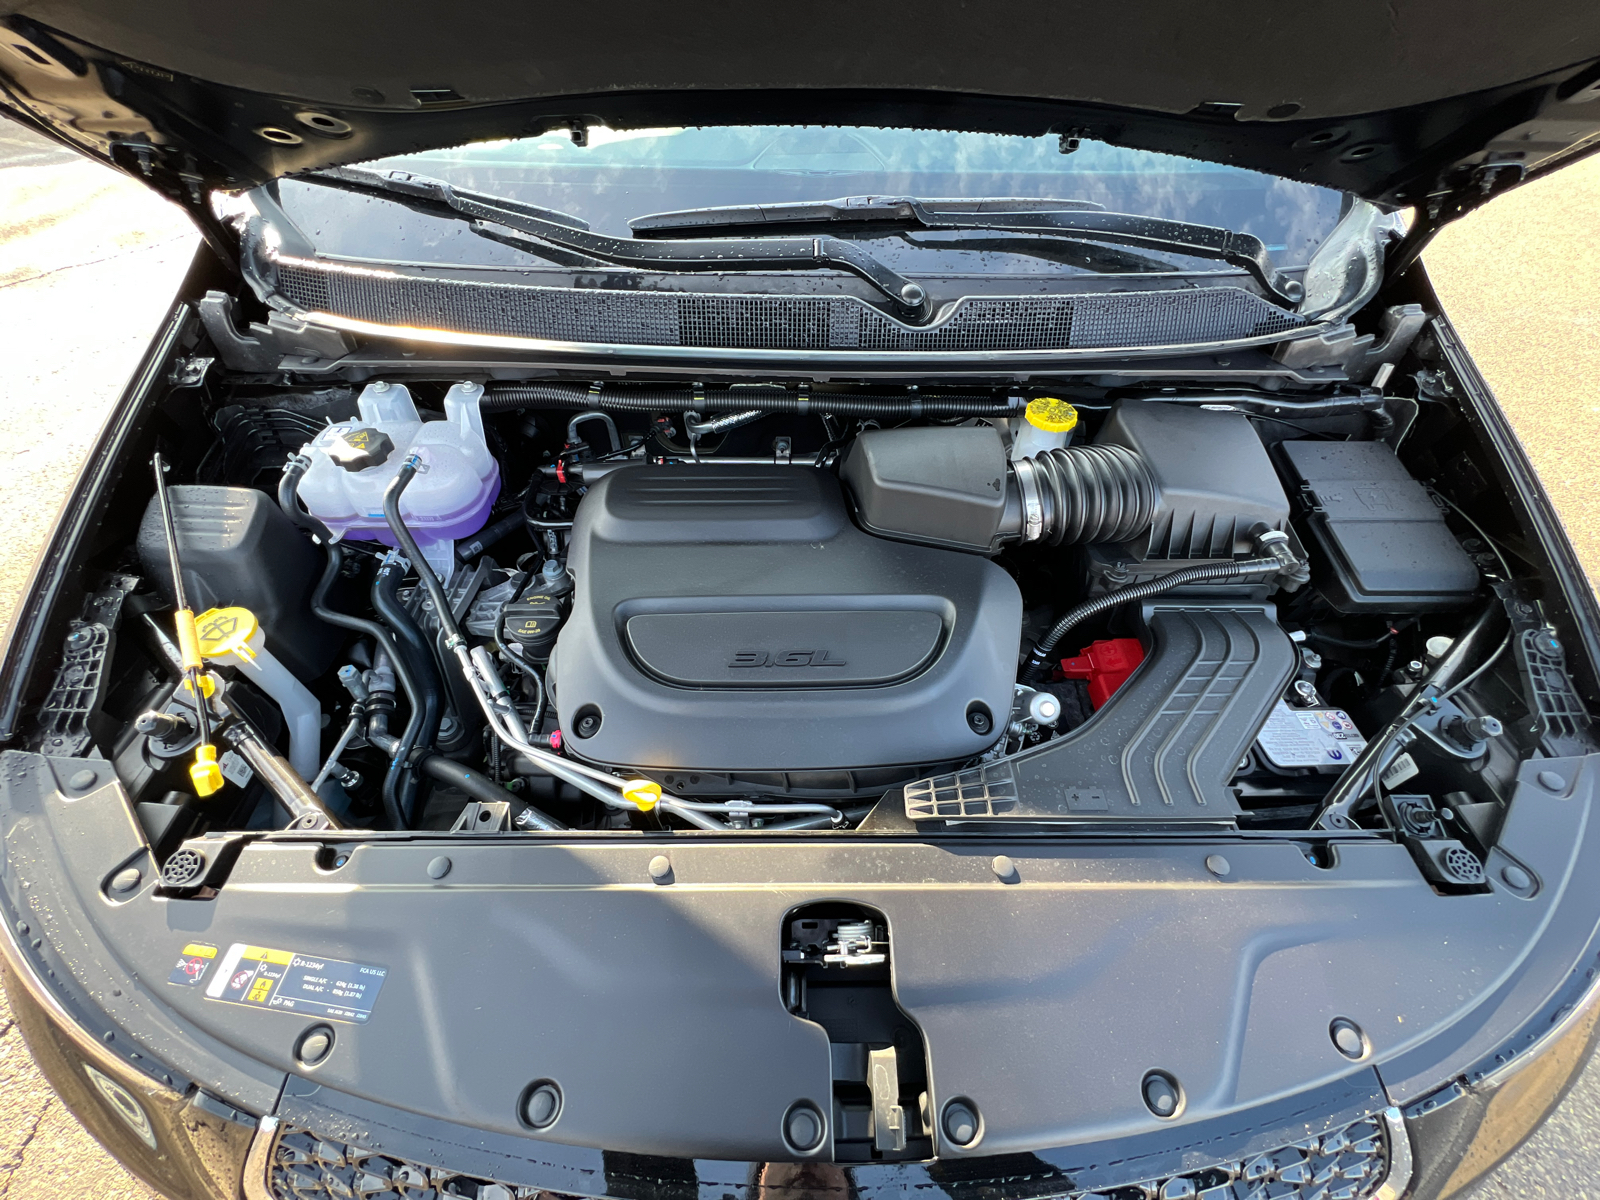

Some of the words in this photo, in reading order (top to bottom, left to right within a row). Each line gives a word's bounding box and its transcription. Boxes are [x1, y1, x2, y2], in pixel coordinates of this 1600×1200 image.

[728, 649, 846, 667] 3.6L
[300, 960, 325, 971] R-1234yf
[303, 975, 319, 983] SINGLE
[319, 976, 328, 984] A/C
[302, 983, 315, 991] DUAL
